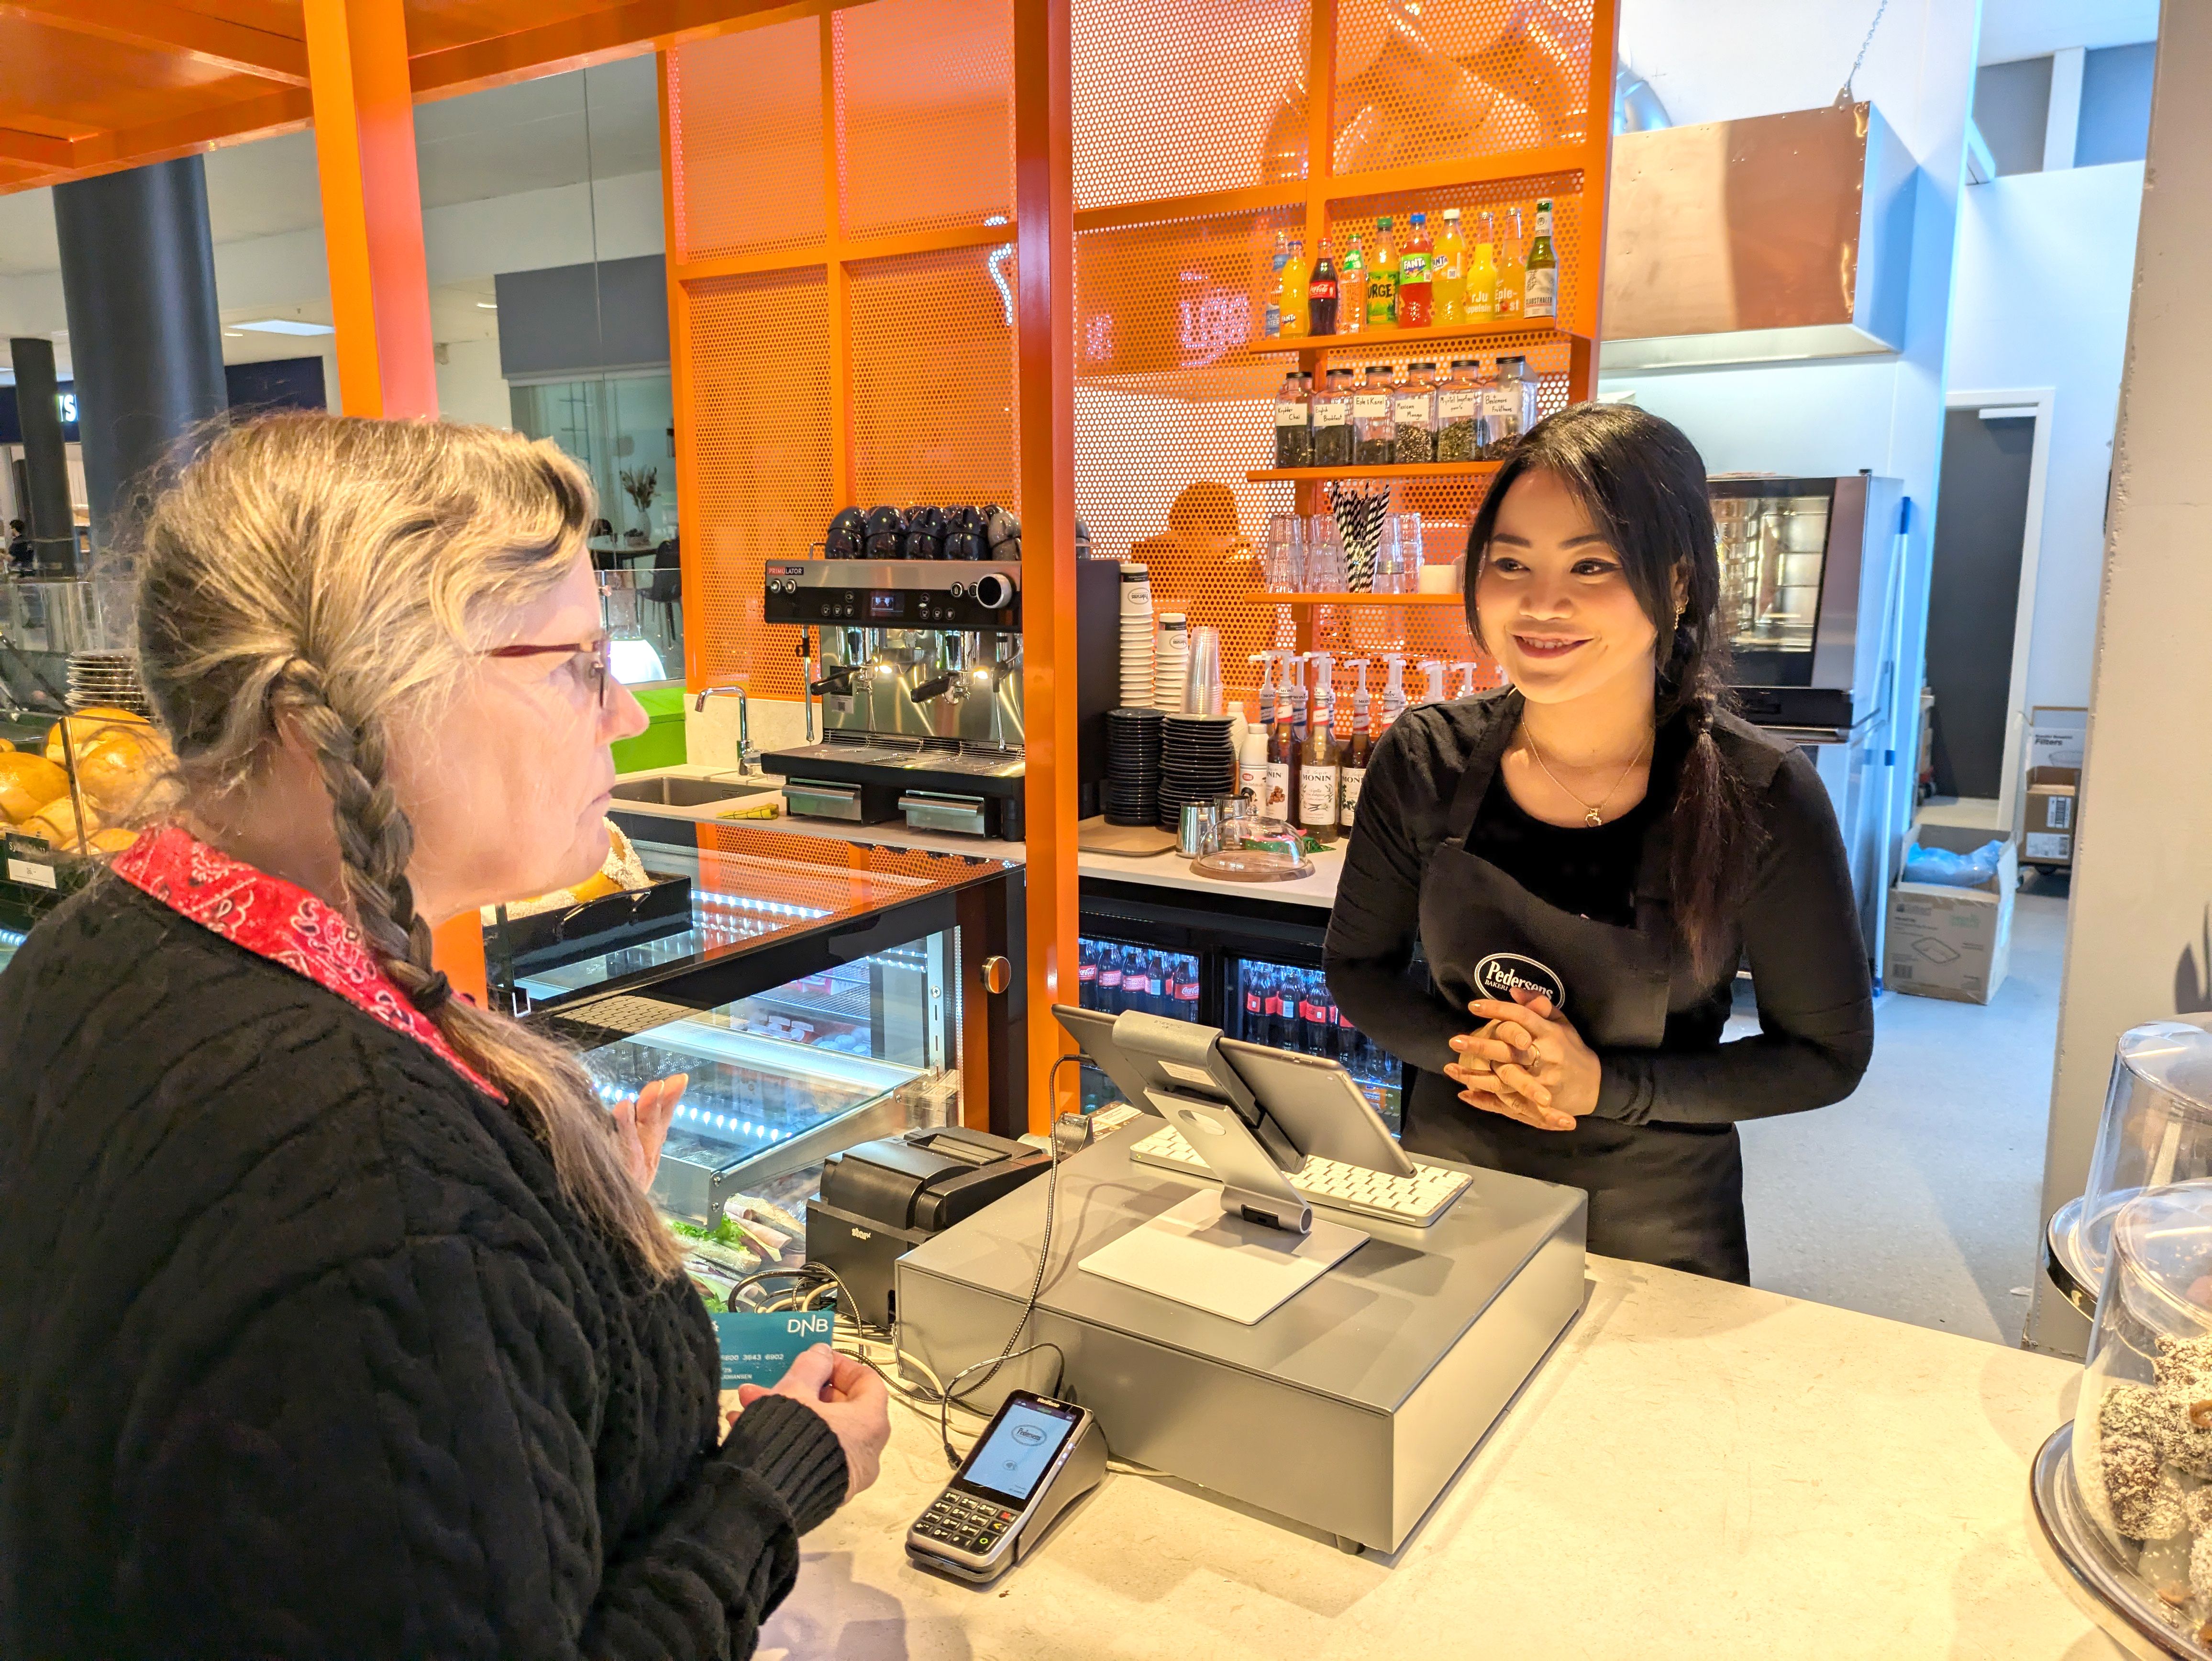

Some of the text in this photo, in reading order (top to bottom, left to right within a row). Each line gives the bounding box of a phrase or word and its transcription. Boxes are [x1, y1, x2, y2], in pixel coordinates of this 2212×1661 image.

[1432, 255, 1448, 266] ANTA
[1367, 283, 1393, 299] URGE
[1370, 397, 1384, 405] Kanel
[1484, 979, 1508, 991] BAKERI
[787, 1314, 829, 1338] DNB
